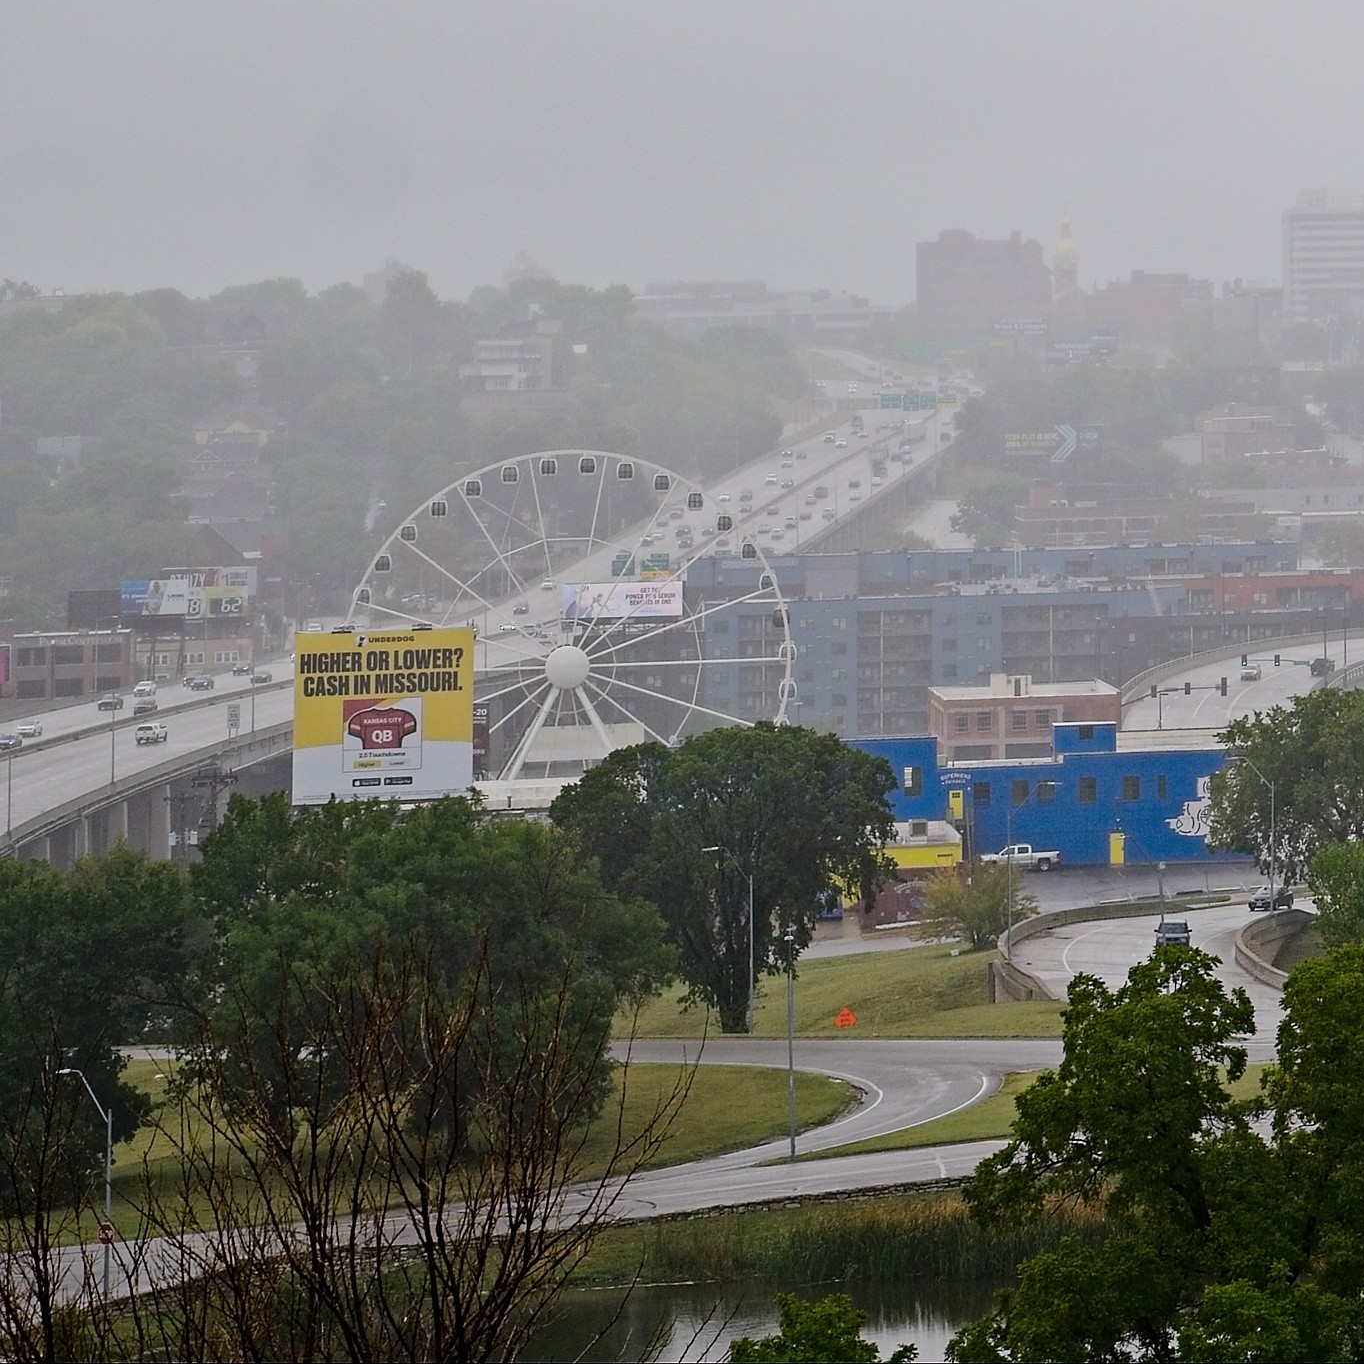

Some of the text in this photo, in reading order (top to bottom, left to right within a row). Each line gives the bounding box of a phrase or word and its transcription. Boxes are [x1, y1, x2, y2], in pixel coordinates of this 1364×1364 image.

[220, 597, 242, 613] 62
[368, 636, 415, 644] UNDERDOG
[300, 647, 464, 674] HIGHER OR LOWER?
[303, 670, 463, 697] CASH IN MISSOURI.
[371, 729, 393, 744] QB
